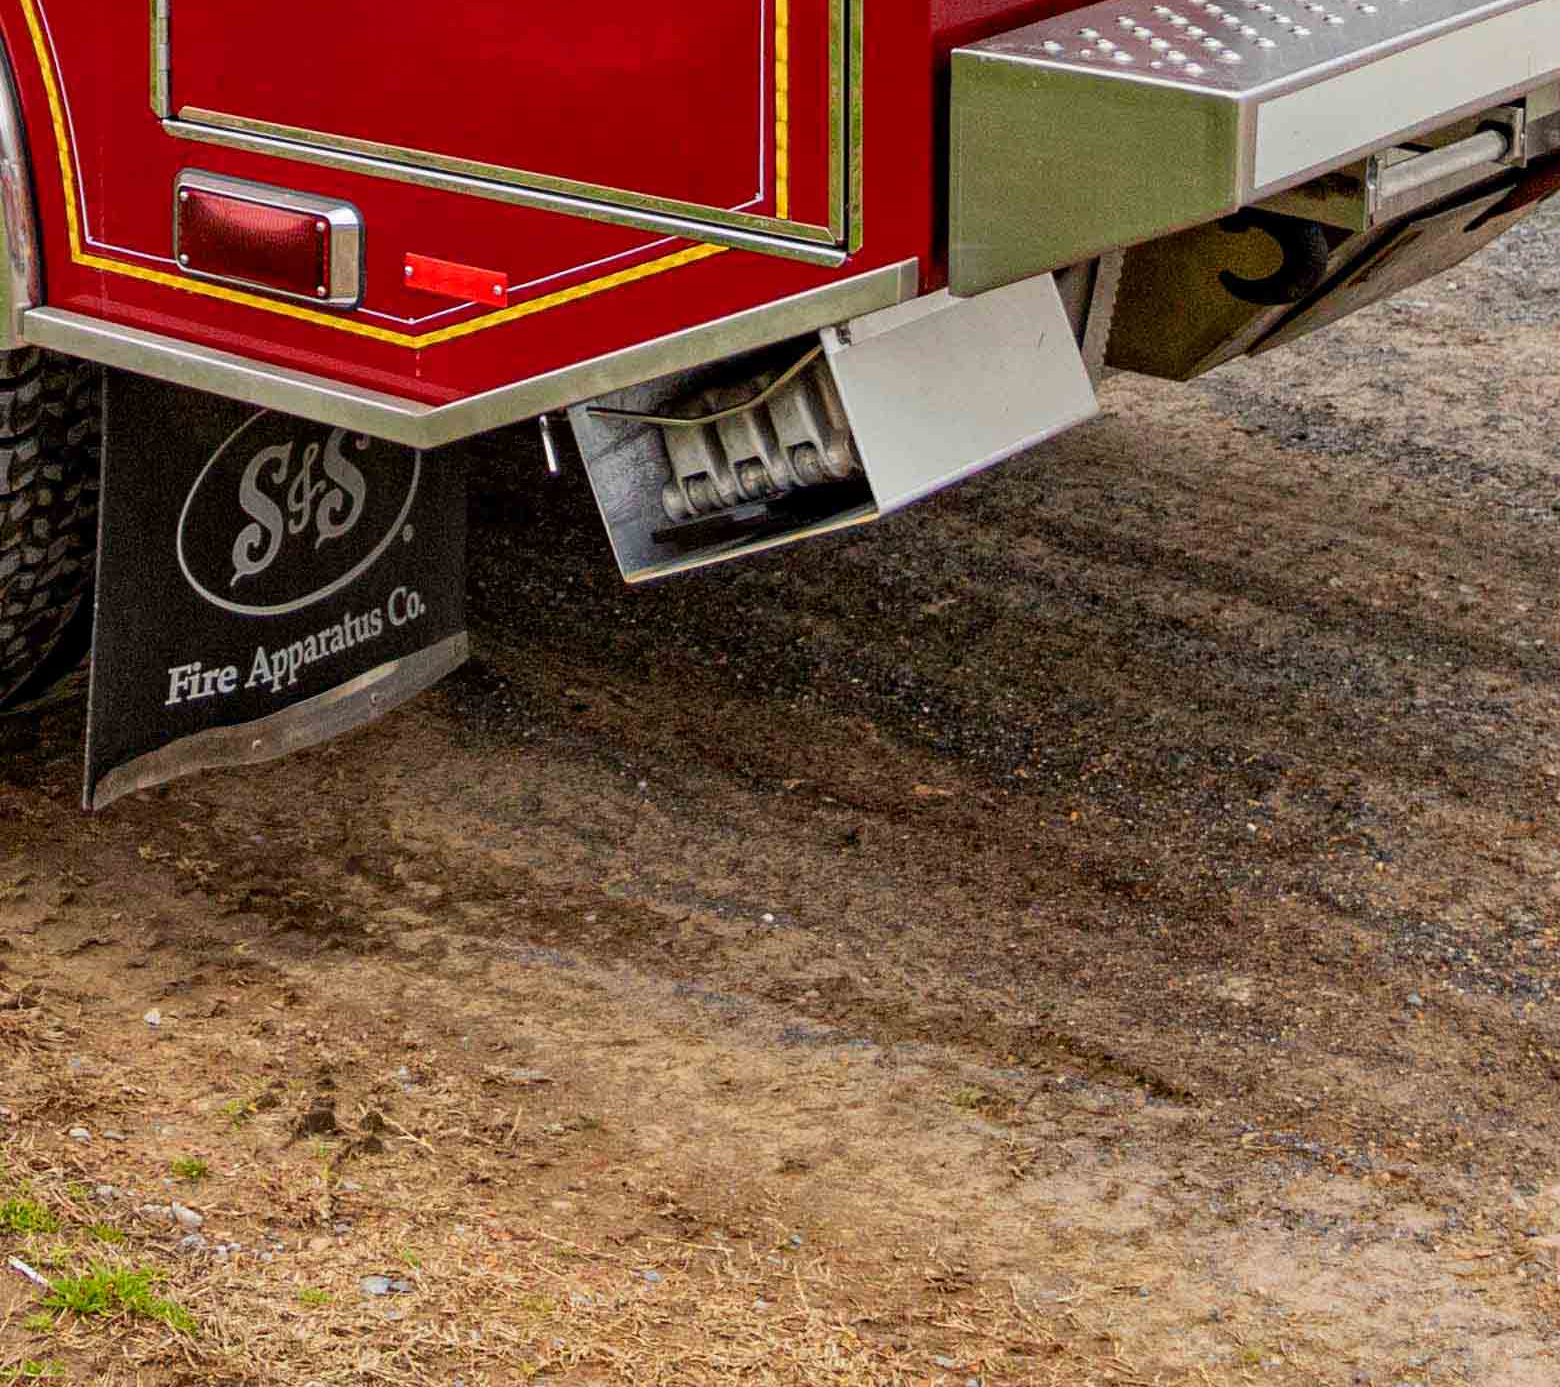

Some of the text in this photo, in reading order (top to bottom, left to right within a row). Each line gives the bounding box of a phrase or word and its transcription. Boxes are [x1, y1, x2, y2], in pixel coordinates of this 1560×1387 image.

[164, 586, 427, 707] Fire Apparatus Co.
